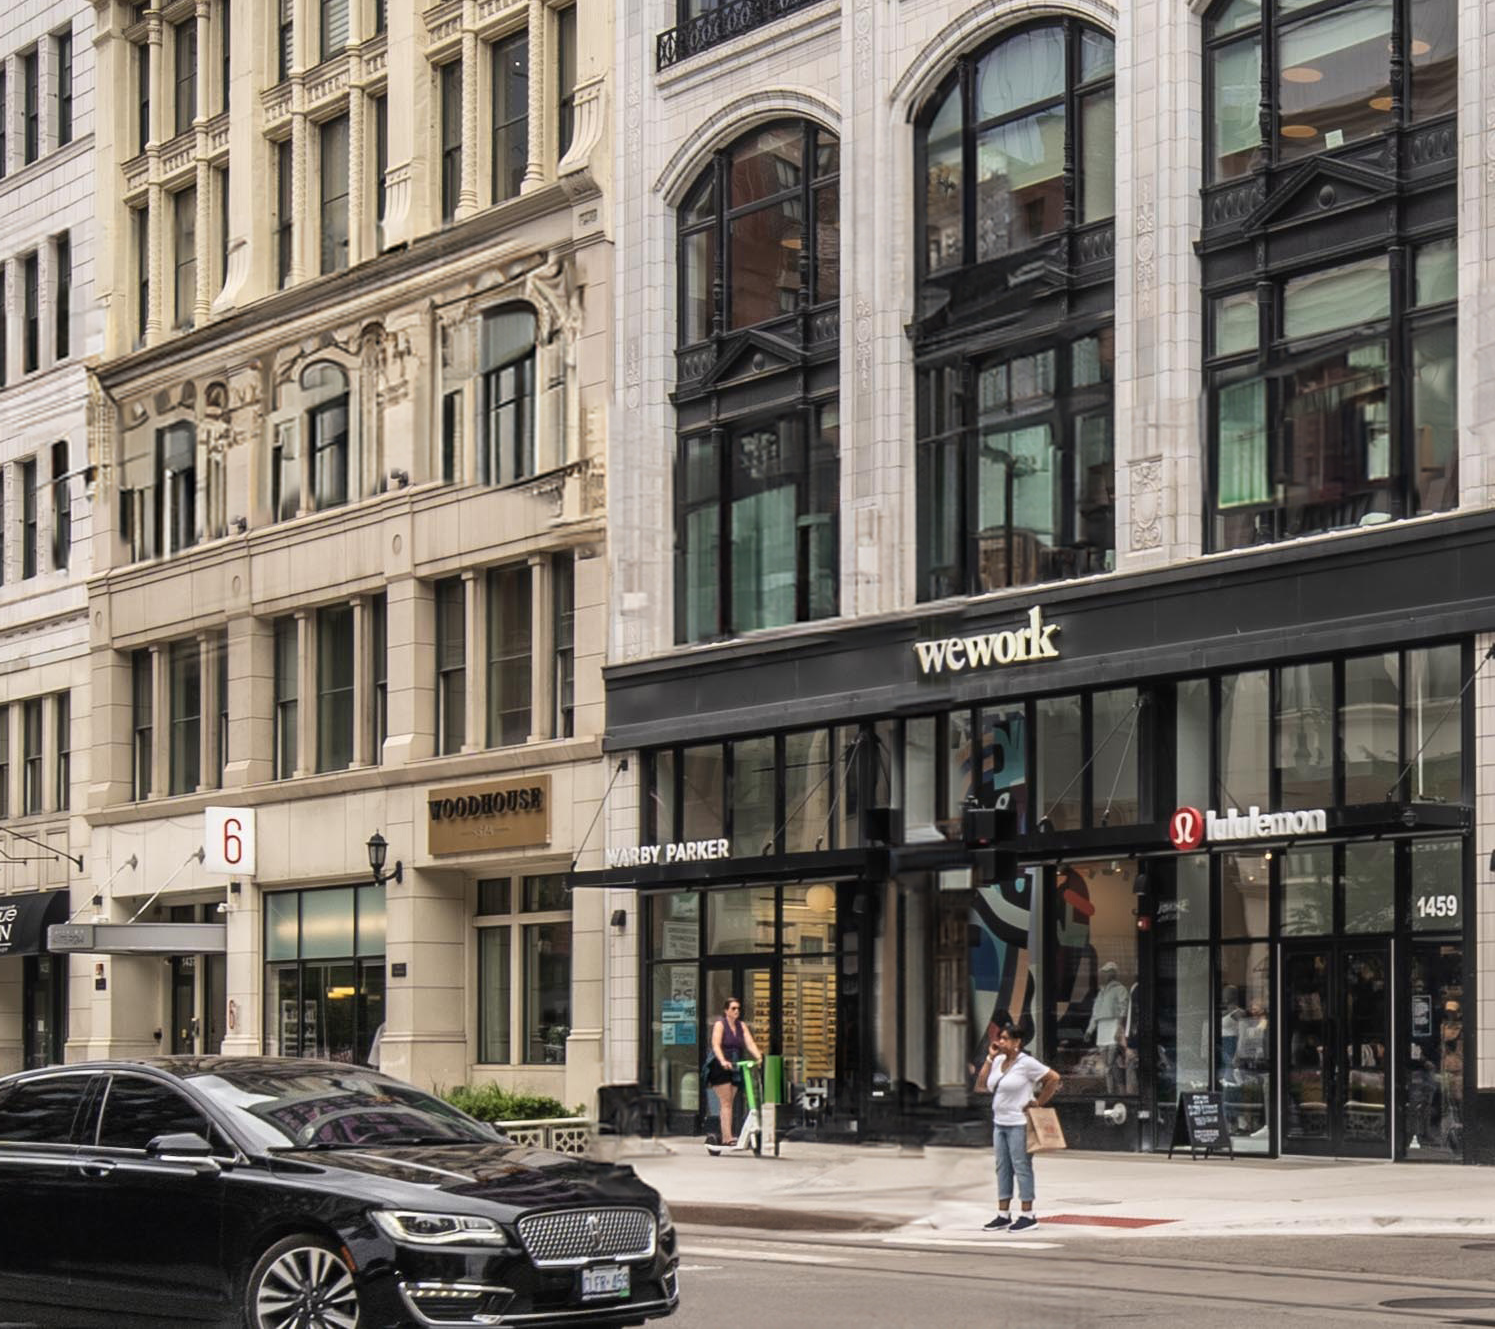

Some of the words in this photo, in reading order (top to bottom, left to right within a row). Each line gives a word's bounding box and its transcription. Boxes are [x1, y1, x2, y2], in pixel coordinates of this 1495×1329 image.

[914, 605, 1060, 674] wework
[427, 787, 543, 821] WOODHOUSE
[1206, 806, 1327, 841] lululemon
[224, 818, 242, 865] 6
[605, 844, 661, 868] WARBY
[665, 838, 730, 864] PARKER
[1416, 895, 1458, 918] 1459
